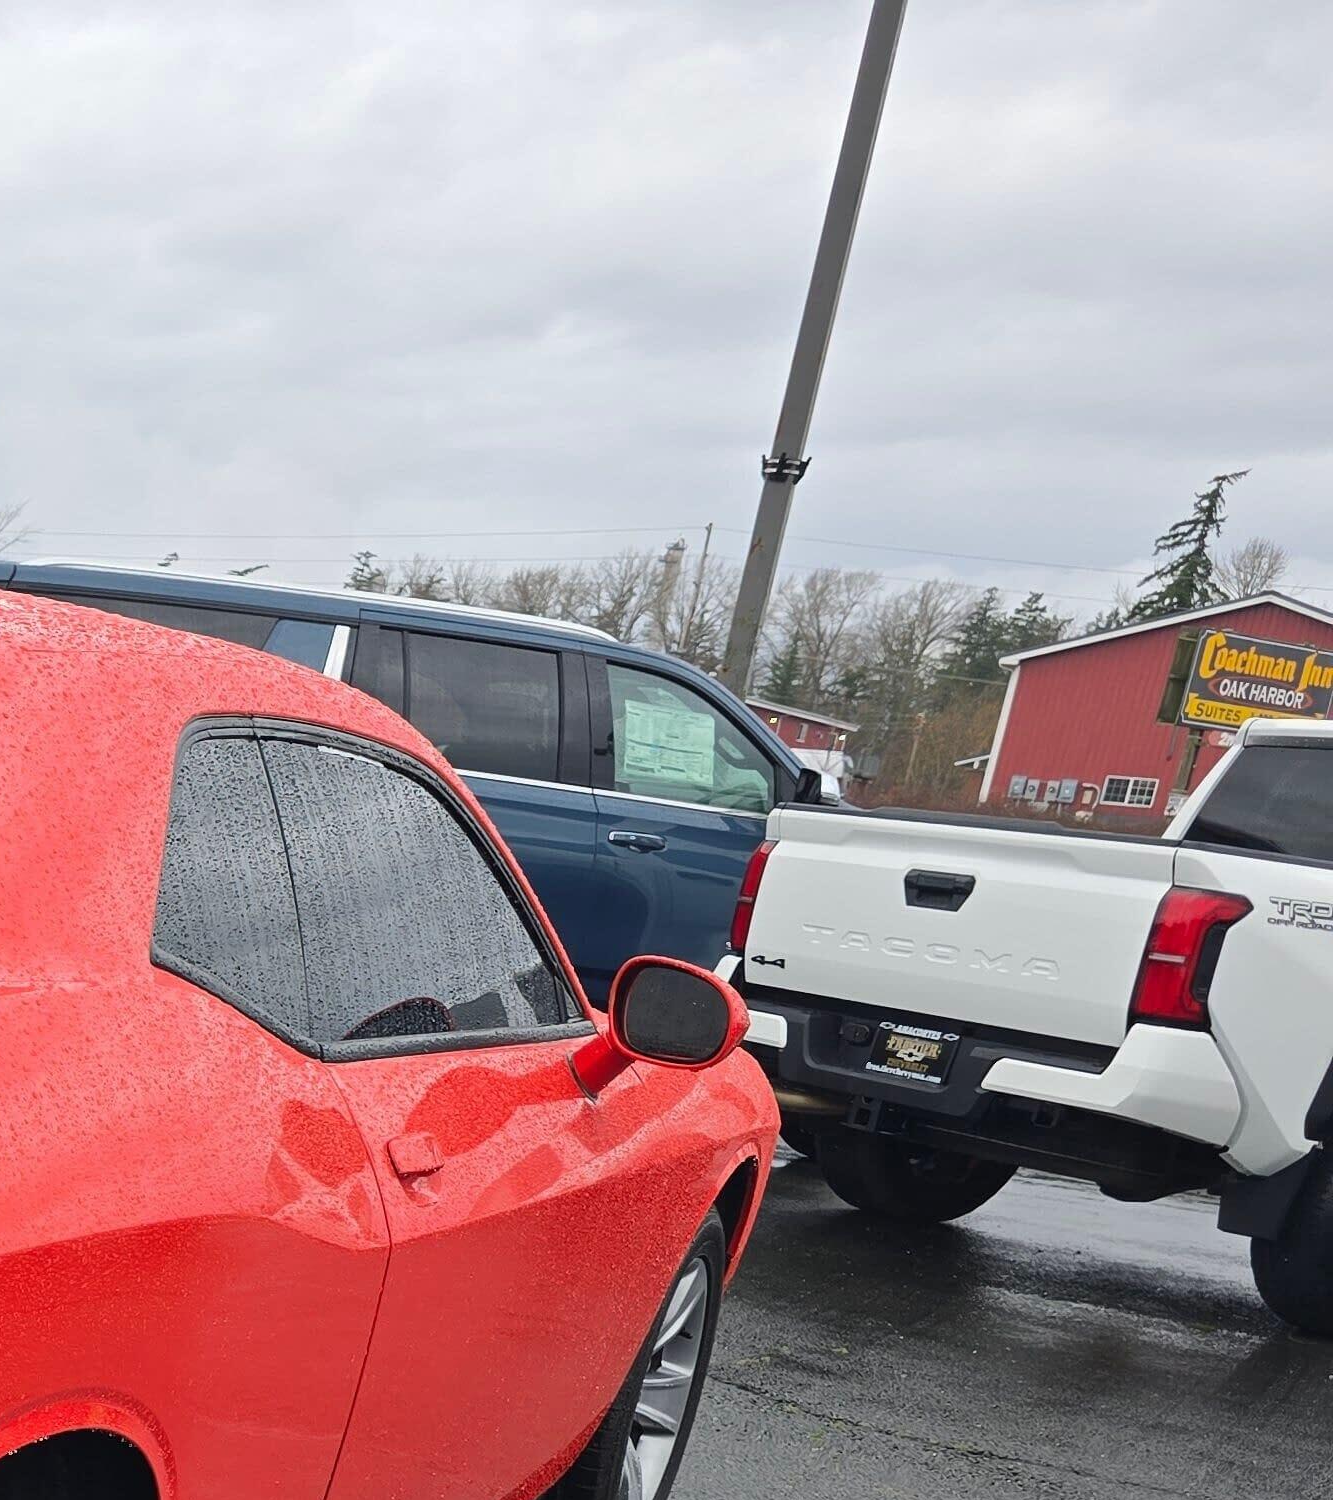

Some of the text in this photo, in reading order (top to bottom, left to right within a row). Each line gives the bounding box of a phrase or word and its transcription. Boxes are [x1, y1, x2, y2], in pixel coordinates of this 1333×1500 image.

[1198, 631, 1333, 692] Coachman Inn
[1219, 678, 1305, 709] OAK HARBOR
[1194, 702, 1242, 722] SUITES
[1269, 896, 1333, 920] TRD
[802, 923, 1060, 981] TACOMA
